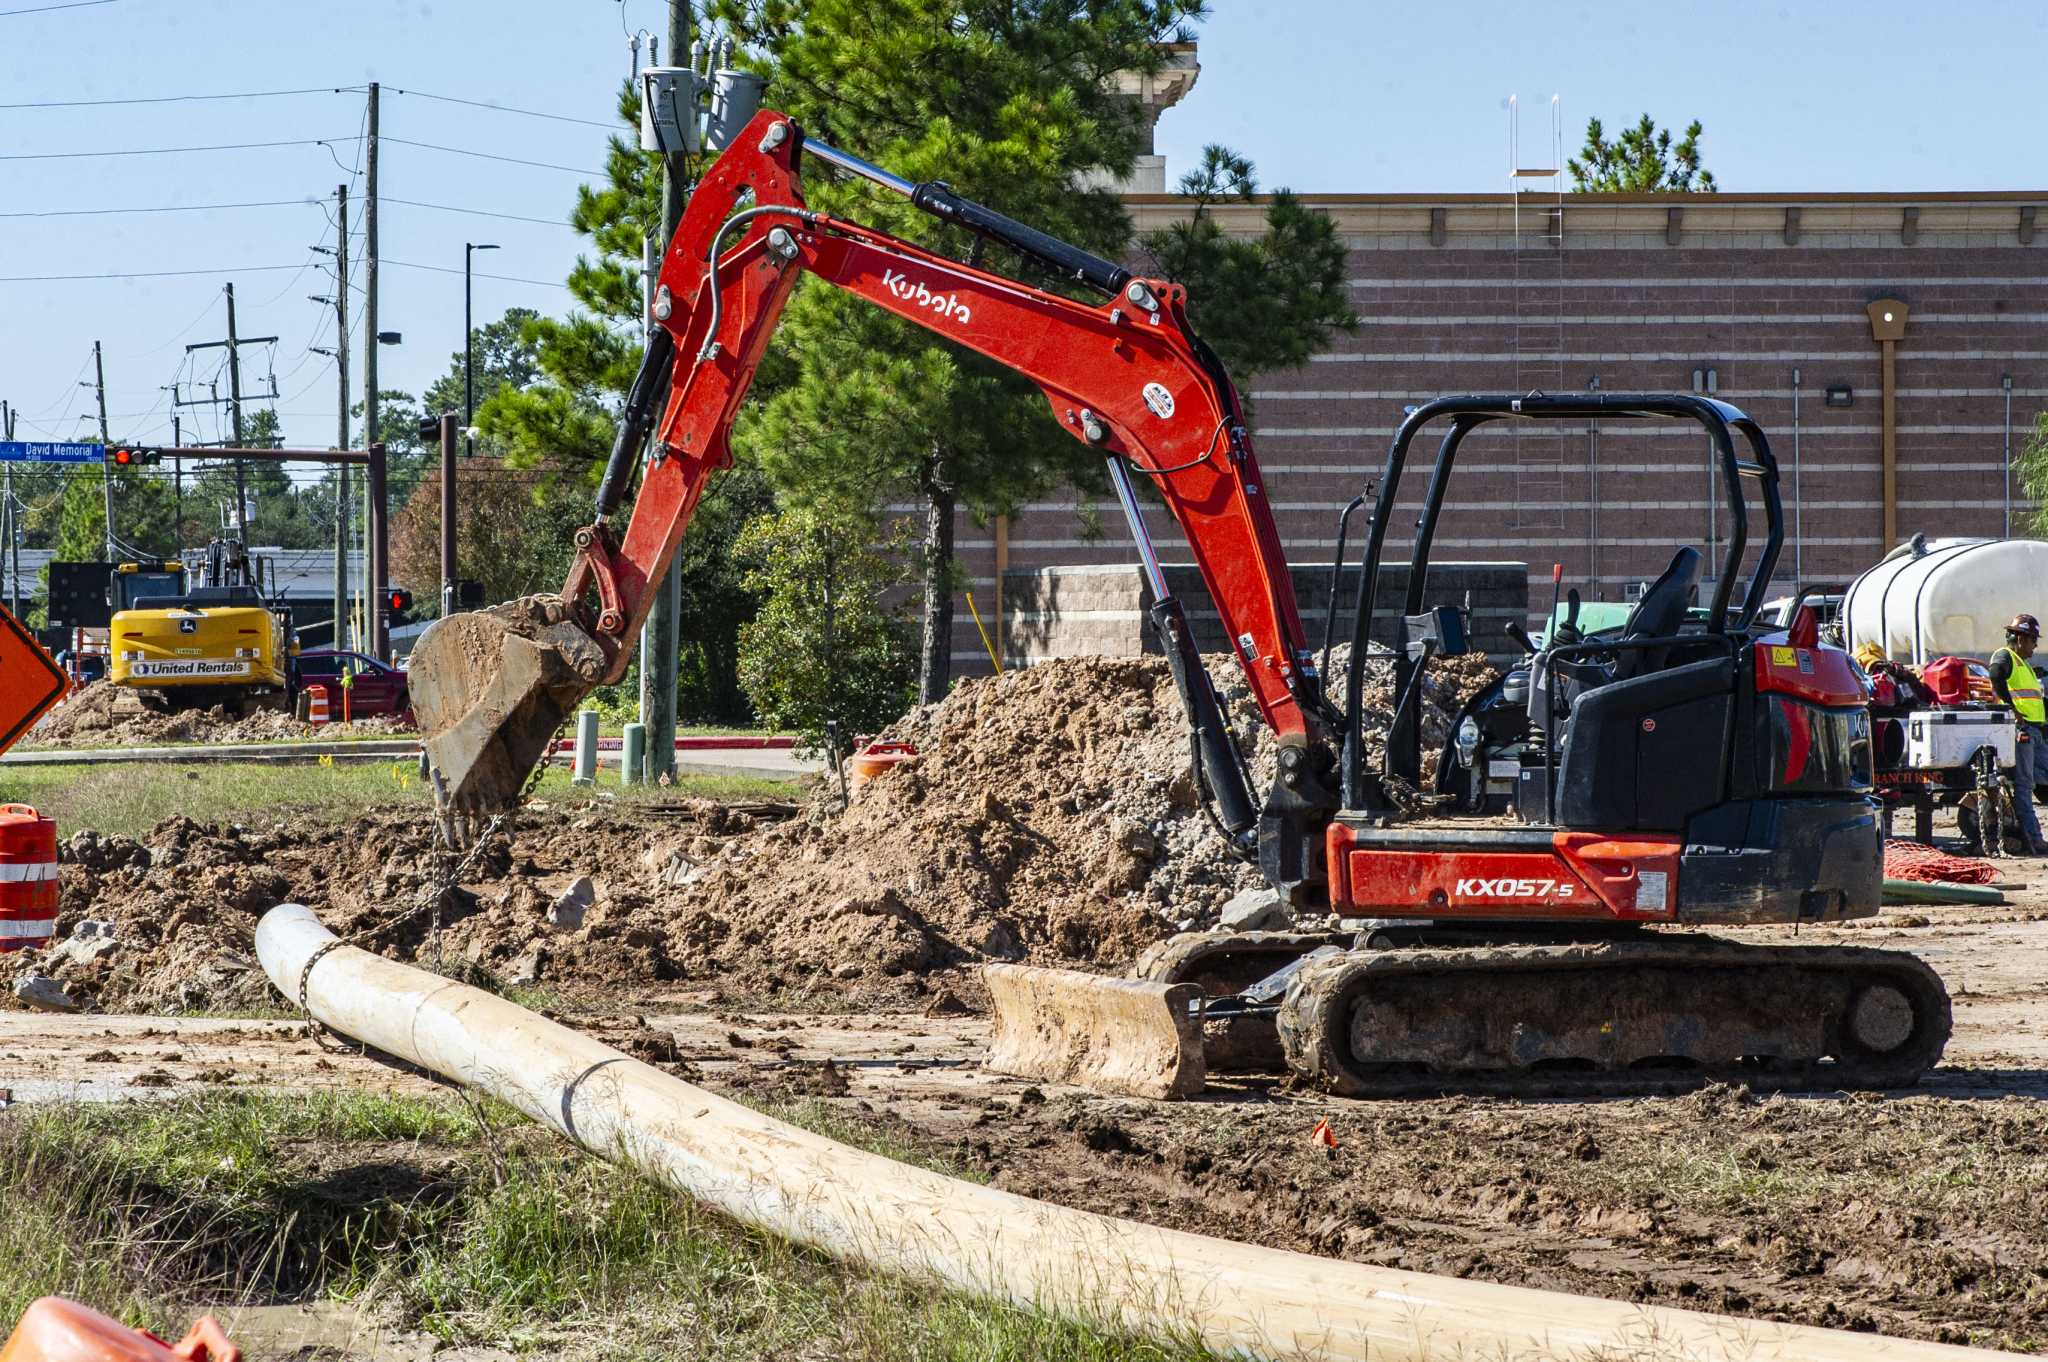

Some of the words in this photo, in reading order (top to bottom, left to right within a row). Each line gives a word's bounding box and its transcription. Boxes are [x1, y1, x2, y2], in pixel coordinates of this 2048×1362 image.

[882, 269, 971, 324] Kubota
[25, 443, 50, 456] David
[53, 444, 93, 456] Memorial
[152, 662, 194, 674] United
[196, 662, 244, 673] Rentals
[1455, 879, 1574, 897] KX057-5
